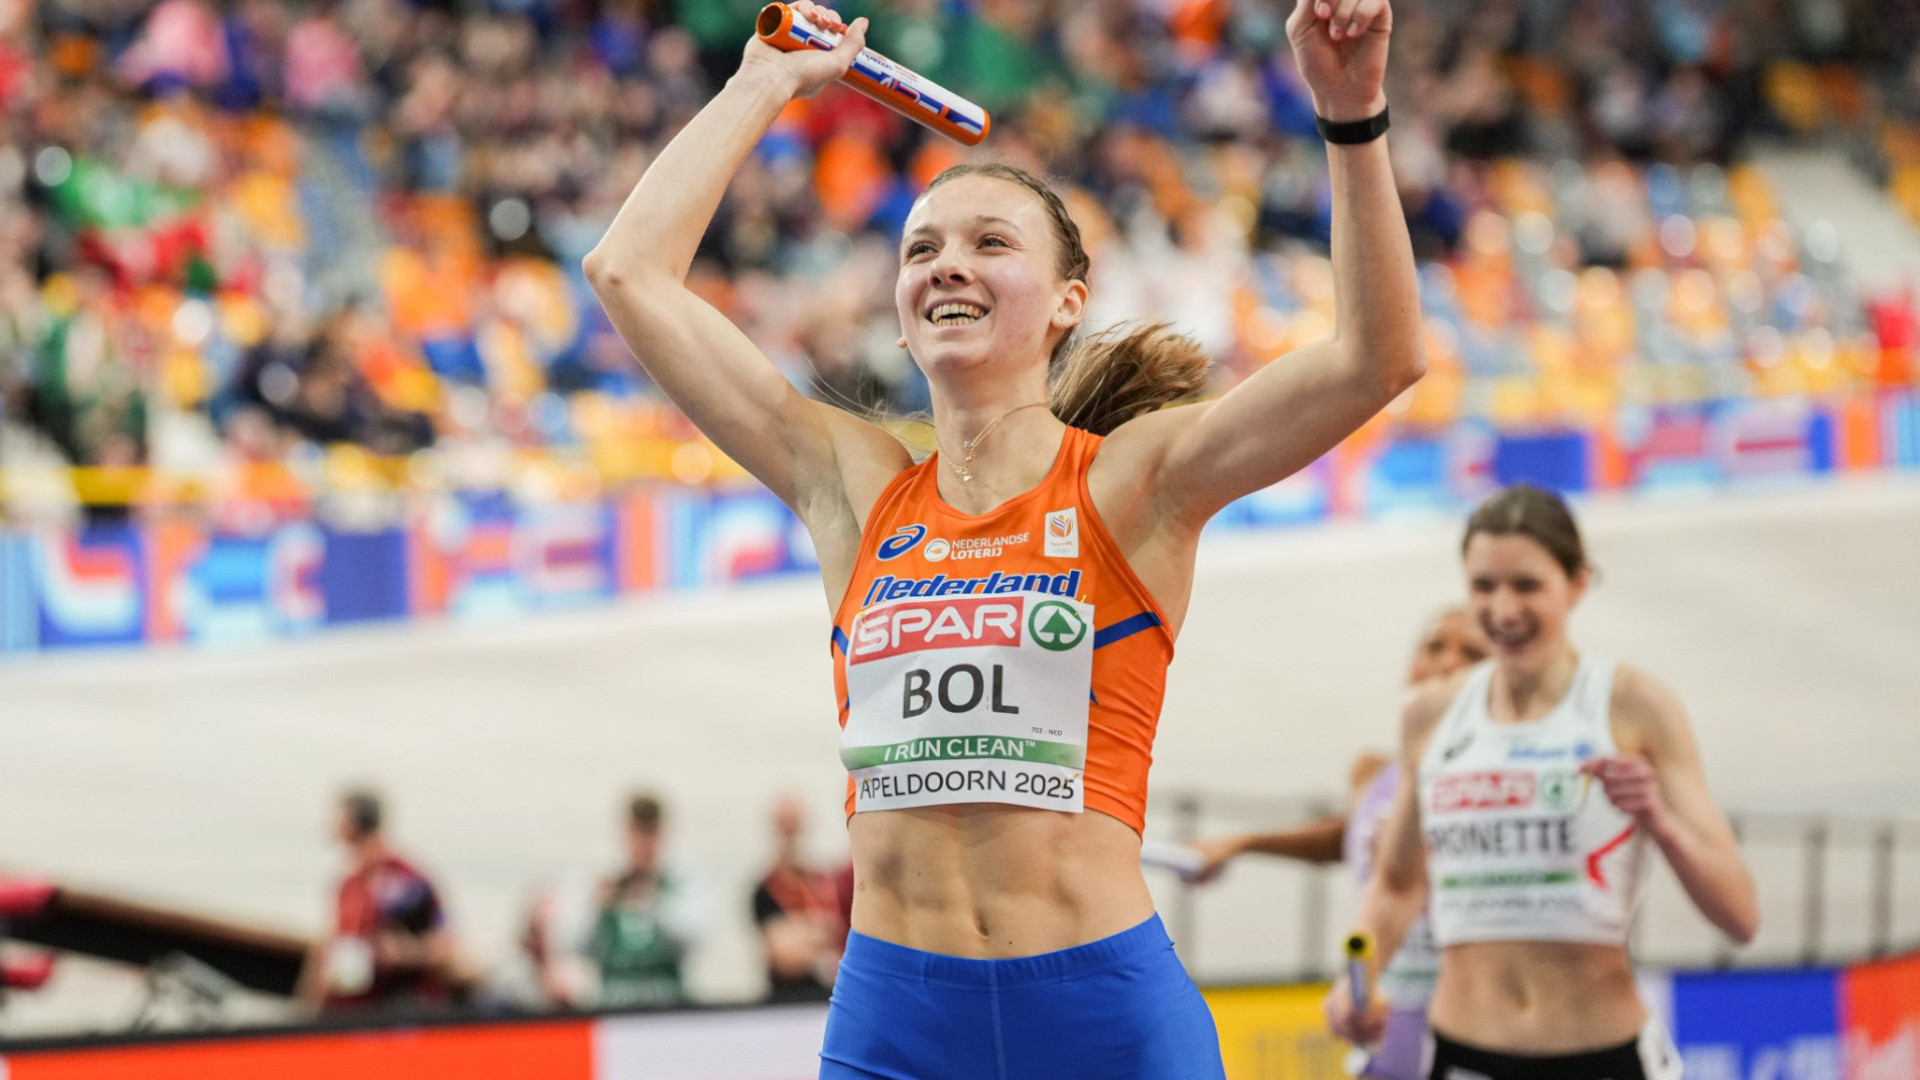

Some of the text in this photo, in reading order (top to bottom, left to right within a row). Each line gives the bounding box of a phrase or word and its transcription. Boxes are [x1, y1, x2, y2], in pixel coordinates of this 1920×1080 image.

[951, 532, 1029, 549] NEDERLANDSE
[950, 547, 1003, 561] LOTERIJ
[855, 604, 1016, 655] SPAR
[902, 663, 1020, 719] BOL
[1048, 728, 1063, 737] NED
[884, 747, 891, 762] I
[894, 740, 942, 761] RUN
[860, 770, 1074, 800] APELDOORN 2025
